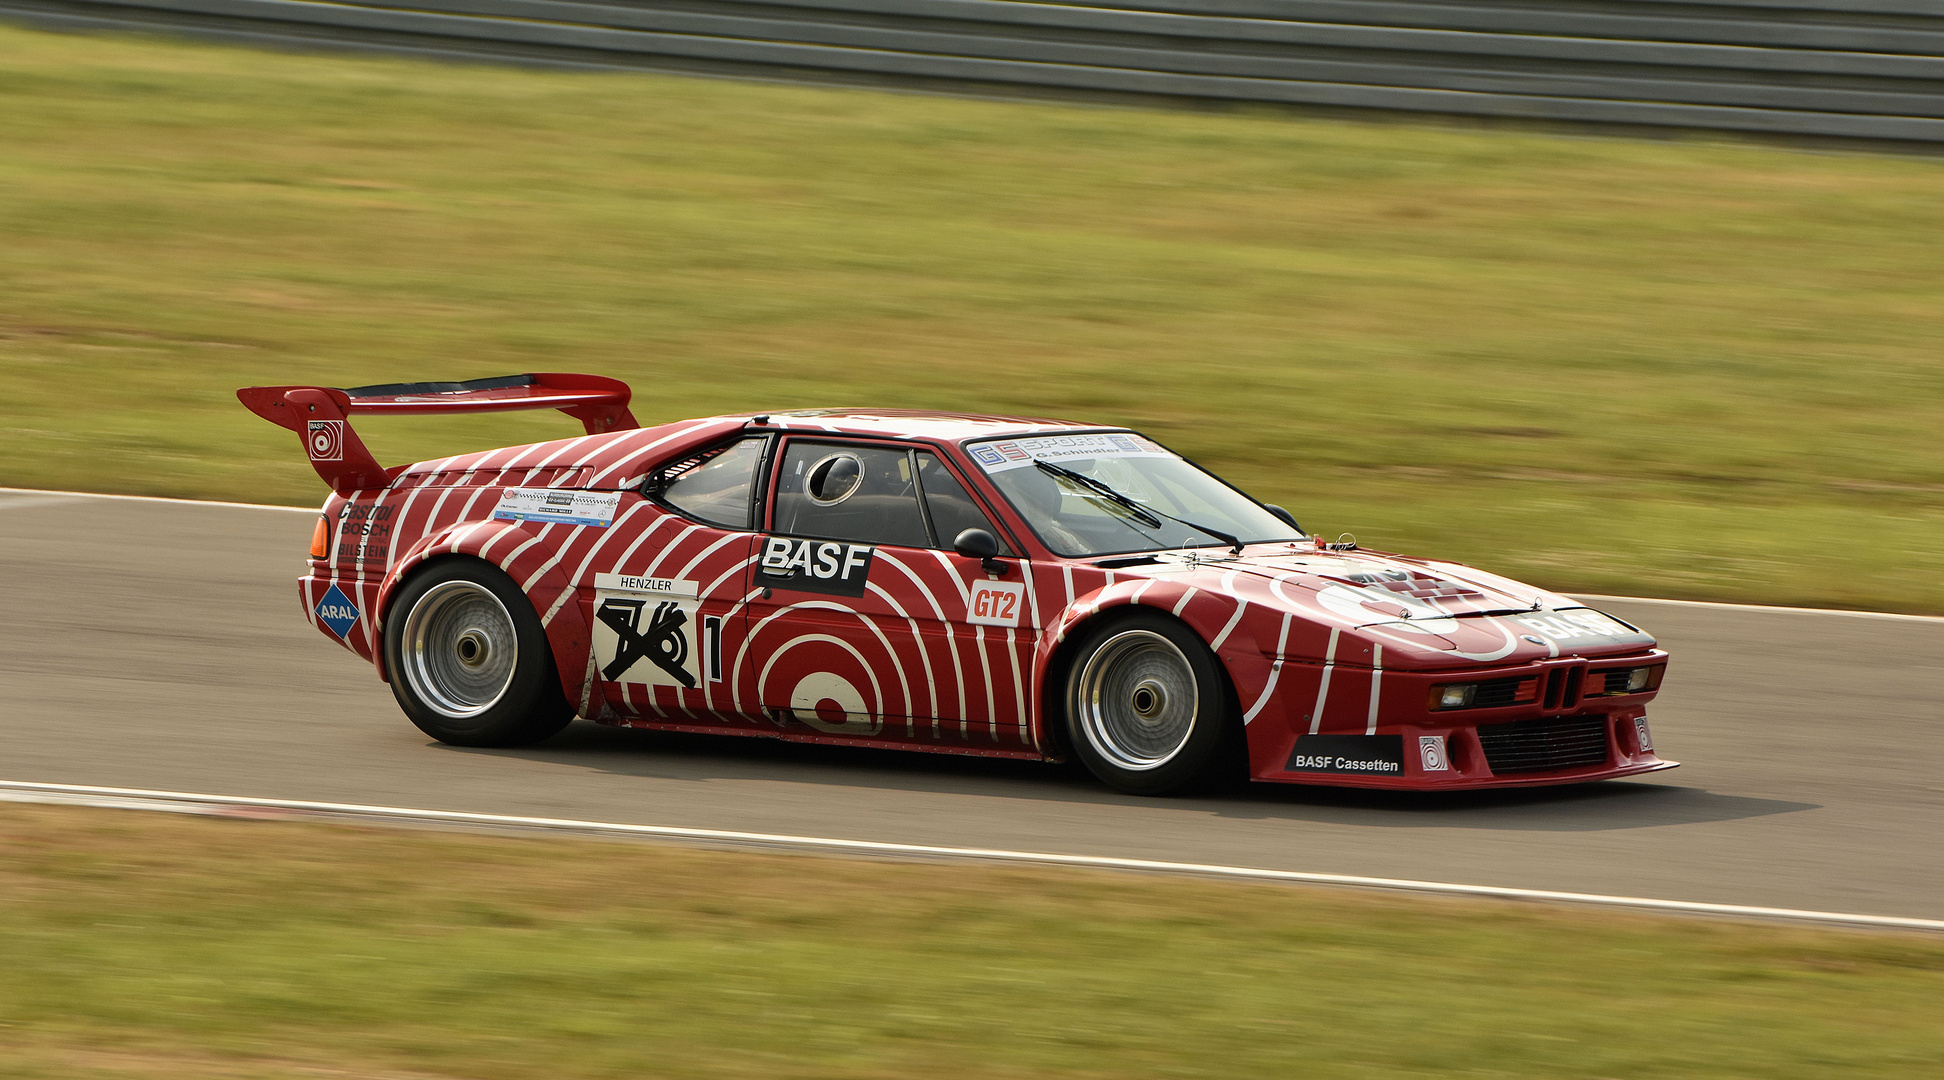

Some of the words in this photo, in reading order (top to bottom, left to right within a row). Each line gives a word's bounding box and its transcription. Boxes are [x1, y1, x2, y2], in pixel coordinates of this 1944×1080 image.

[1018, 435, 1106, 450] SPORT
[337, 501, 396, 521] Castrol
[341, 522, 390, 537] BOSCH
[338, 543, 388, 558] BILSTEIN
[761, 537, 872, 580] BASF
[620, 577, 672, 591] HENZLER
[321, 604, 356, 620] ARAL
[974, 589, 1017, 619] GT2
[1516, 613, 1625, 639] BASF
[1295, 755, 1333, 769] BASF
[1335, 756, 1399, 772] Cassetten
